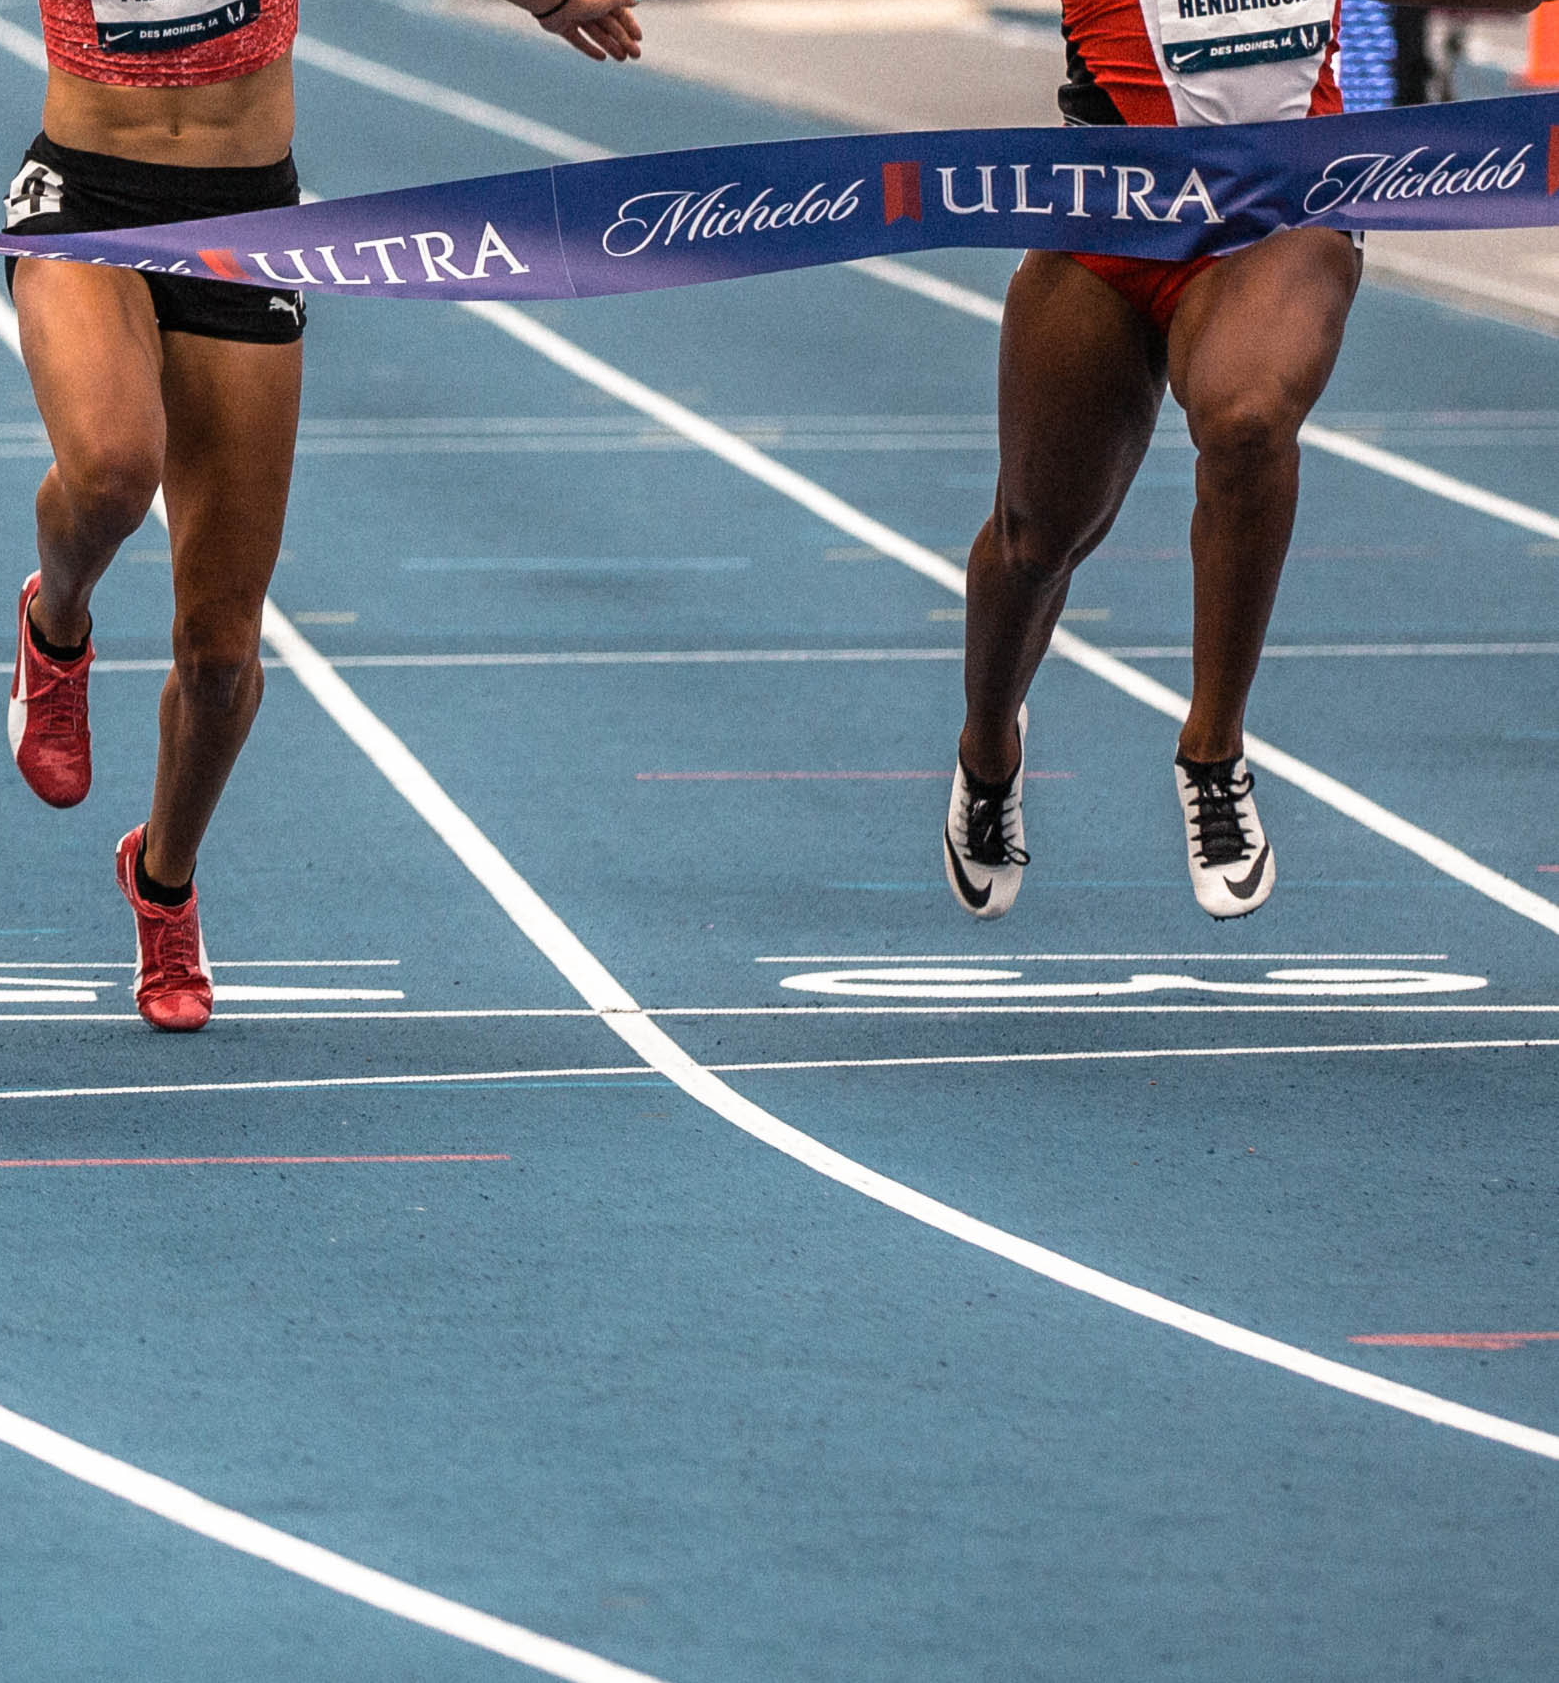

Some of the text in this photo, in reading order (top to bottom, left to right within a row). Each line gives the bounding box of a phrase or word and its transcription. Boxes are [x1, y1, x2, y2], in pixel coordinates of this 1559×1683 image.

[139, 19, 219, 39] DES MOINES, IA
[1210, 46, 1232, 57] DES
[1234, 39, 1278, 53] MOINES,
[602, 163, 1224, 257] Michelob ULTRA
[1303, 143, 1533, 215] Michelob
[248, 221, 529, 284] ULTRA
